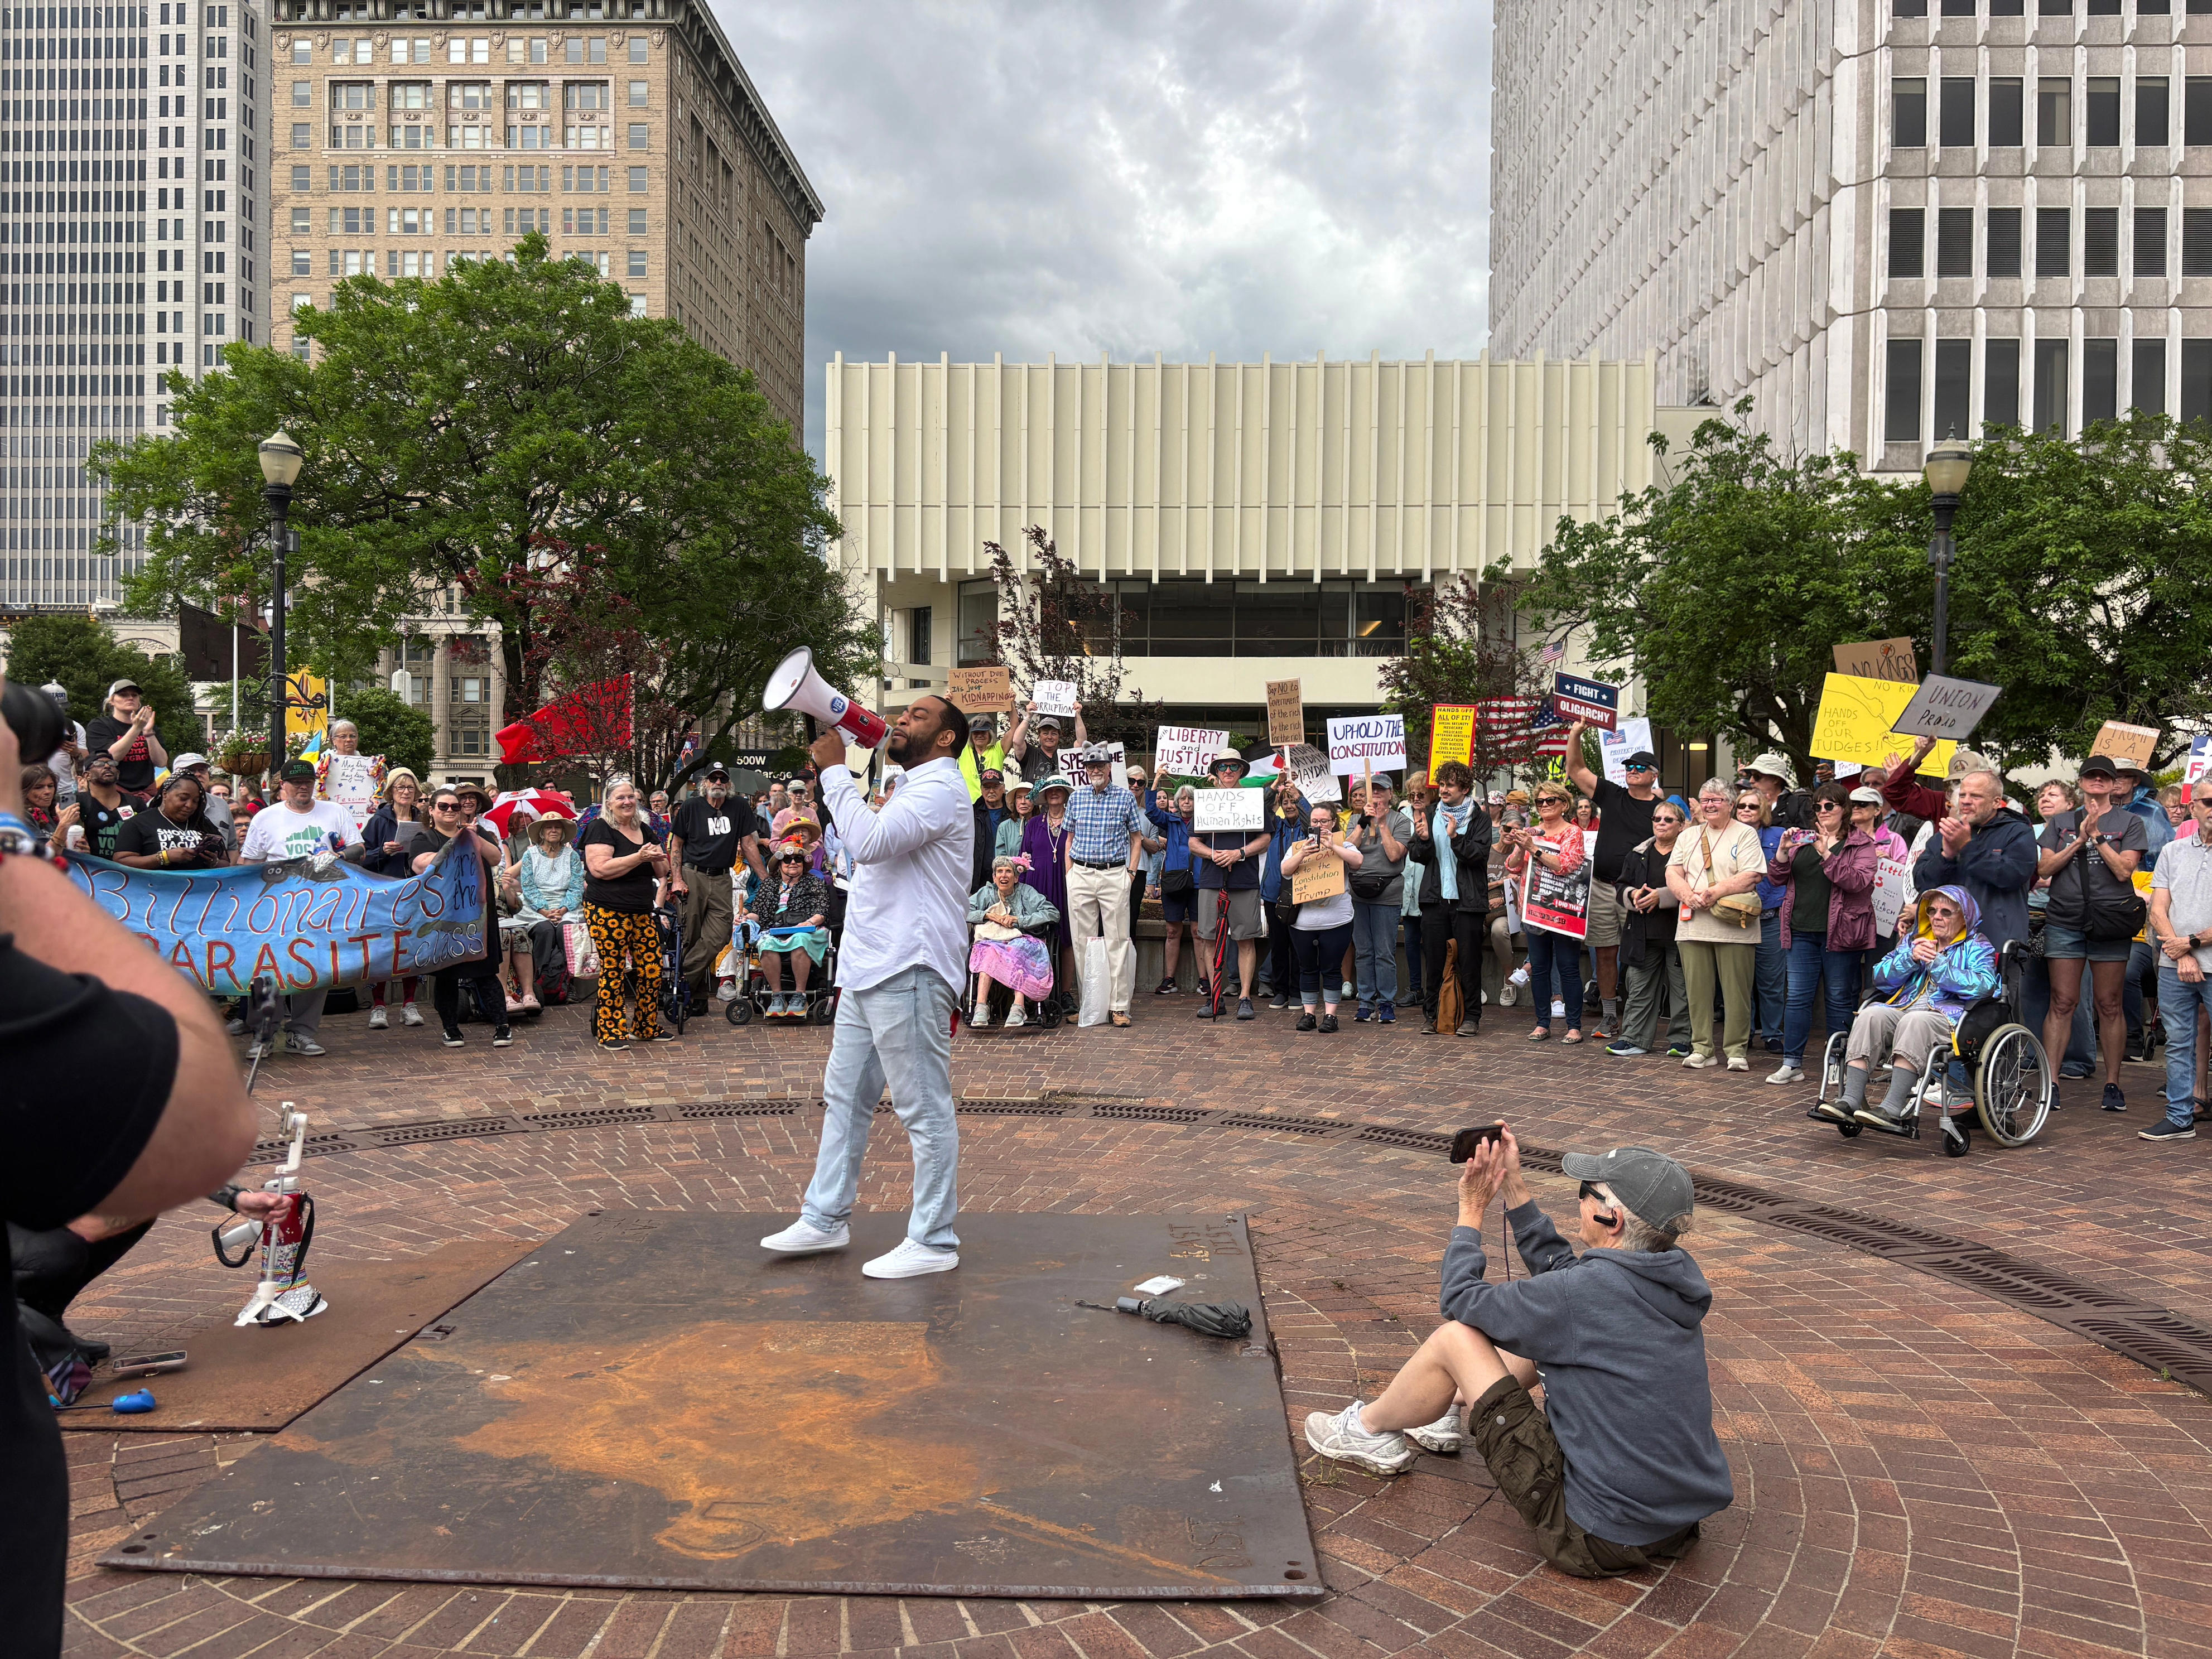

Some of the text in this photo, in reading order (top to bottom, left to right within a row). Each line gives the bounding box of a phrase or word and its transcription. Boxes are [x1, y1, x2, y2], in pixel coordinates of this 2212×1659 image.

[1852, 653, 1915, 681] NO KINGS
[1037, 681, 1071, 693] STOP
[1268, 682, 1299, 696] Say NO to
[1573, 683, 1599, 700] FIGHT
[1873, 681, 1917, 693] NO KIN
[961, 692, 1010, 705] KIDNAPPING
[1045, 692, 1061, 702] THE
[1268, 696, 1300, 707] Government
[1928, 684, 1985, 710] UNION
[1036, 702, 1074, 715] ORRUPTION
[1270, 708, 1301, 719] of the rich
[1560, 700, 1610, 724] OLIGARCHY
[1824, 707, 1858, 720] HANDS
[1271, 724, 1278, 734] by
[1279, 722, 1289, 731] the
[1333, 719, 1404, 740] UPHOLD THE
[1823, 728, 1854, 739] OUR
[1159, 727, 1223, 745] with LIBERTY
[1280, 734, 1290, 742] the
[1290, 733, 1302, 741] rich
[1181, 744, 1200, 752] and
[1331, 740, 1405, 760] CONSTITUTION
[1815, 739, 1883, 753] JUDGES!!
[2099, 737, 2136, 754] IS A
[736, 755, 767, 765] 500W
[1060, 751, 1124, 770] SPE HE
[1158, 749, 1219, 766] JUSTICE
[1165, 763, 1183, 773] for
[1197, 791, 1245, 802] HANDS
[1205, 802, 1237, 812] OFF
[707, 816, 731, 836] NO
[1197, 813, 1262, 828] Human Rights
[156, 828, 203, 837] SHOWIN
[453, 851, 476, 881] are
[1318, 862, 1331, 870] the
[1880, 862, 1902, 876] Littl
[1294, 871, 1339, 886] Constitution
[1540, 876, 1565, 888] MEDICARE
[1553, 875, 1569, 884] LUNCH
[1295, 884, 1308, 892] not
[1540, 882, 1563, 893] MEDICAID
[76, 862, 445, 937] Billionaires
[453, 880, 476, 910] the
[1297, 888, 1331, 901] Trump
[1569, 903, 1583, 912] THAT
[414, 923, 484, 968] class
